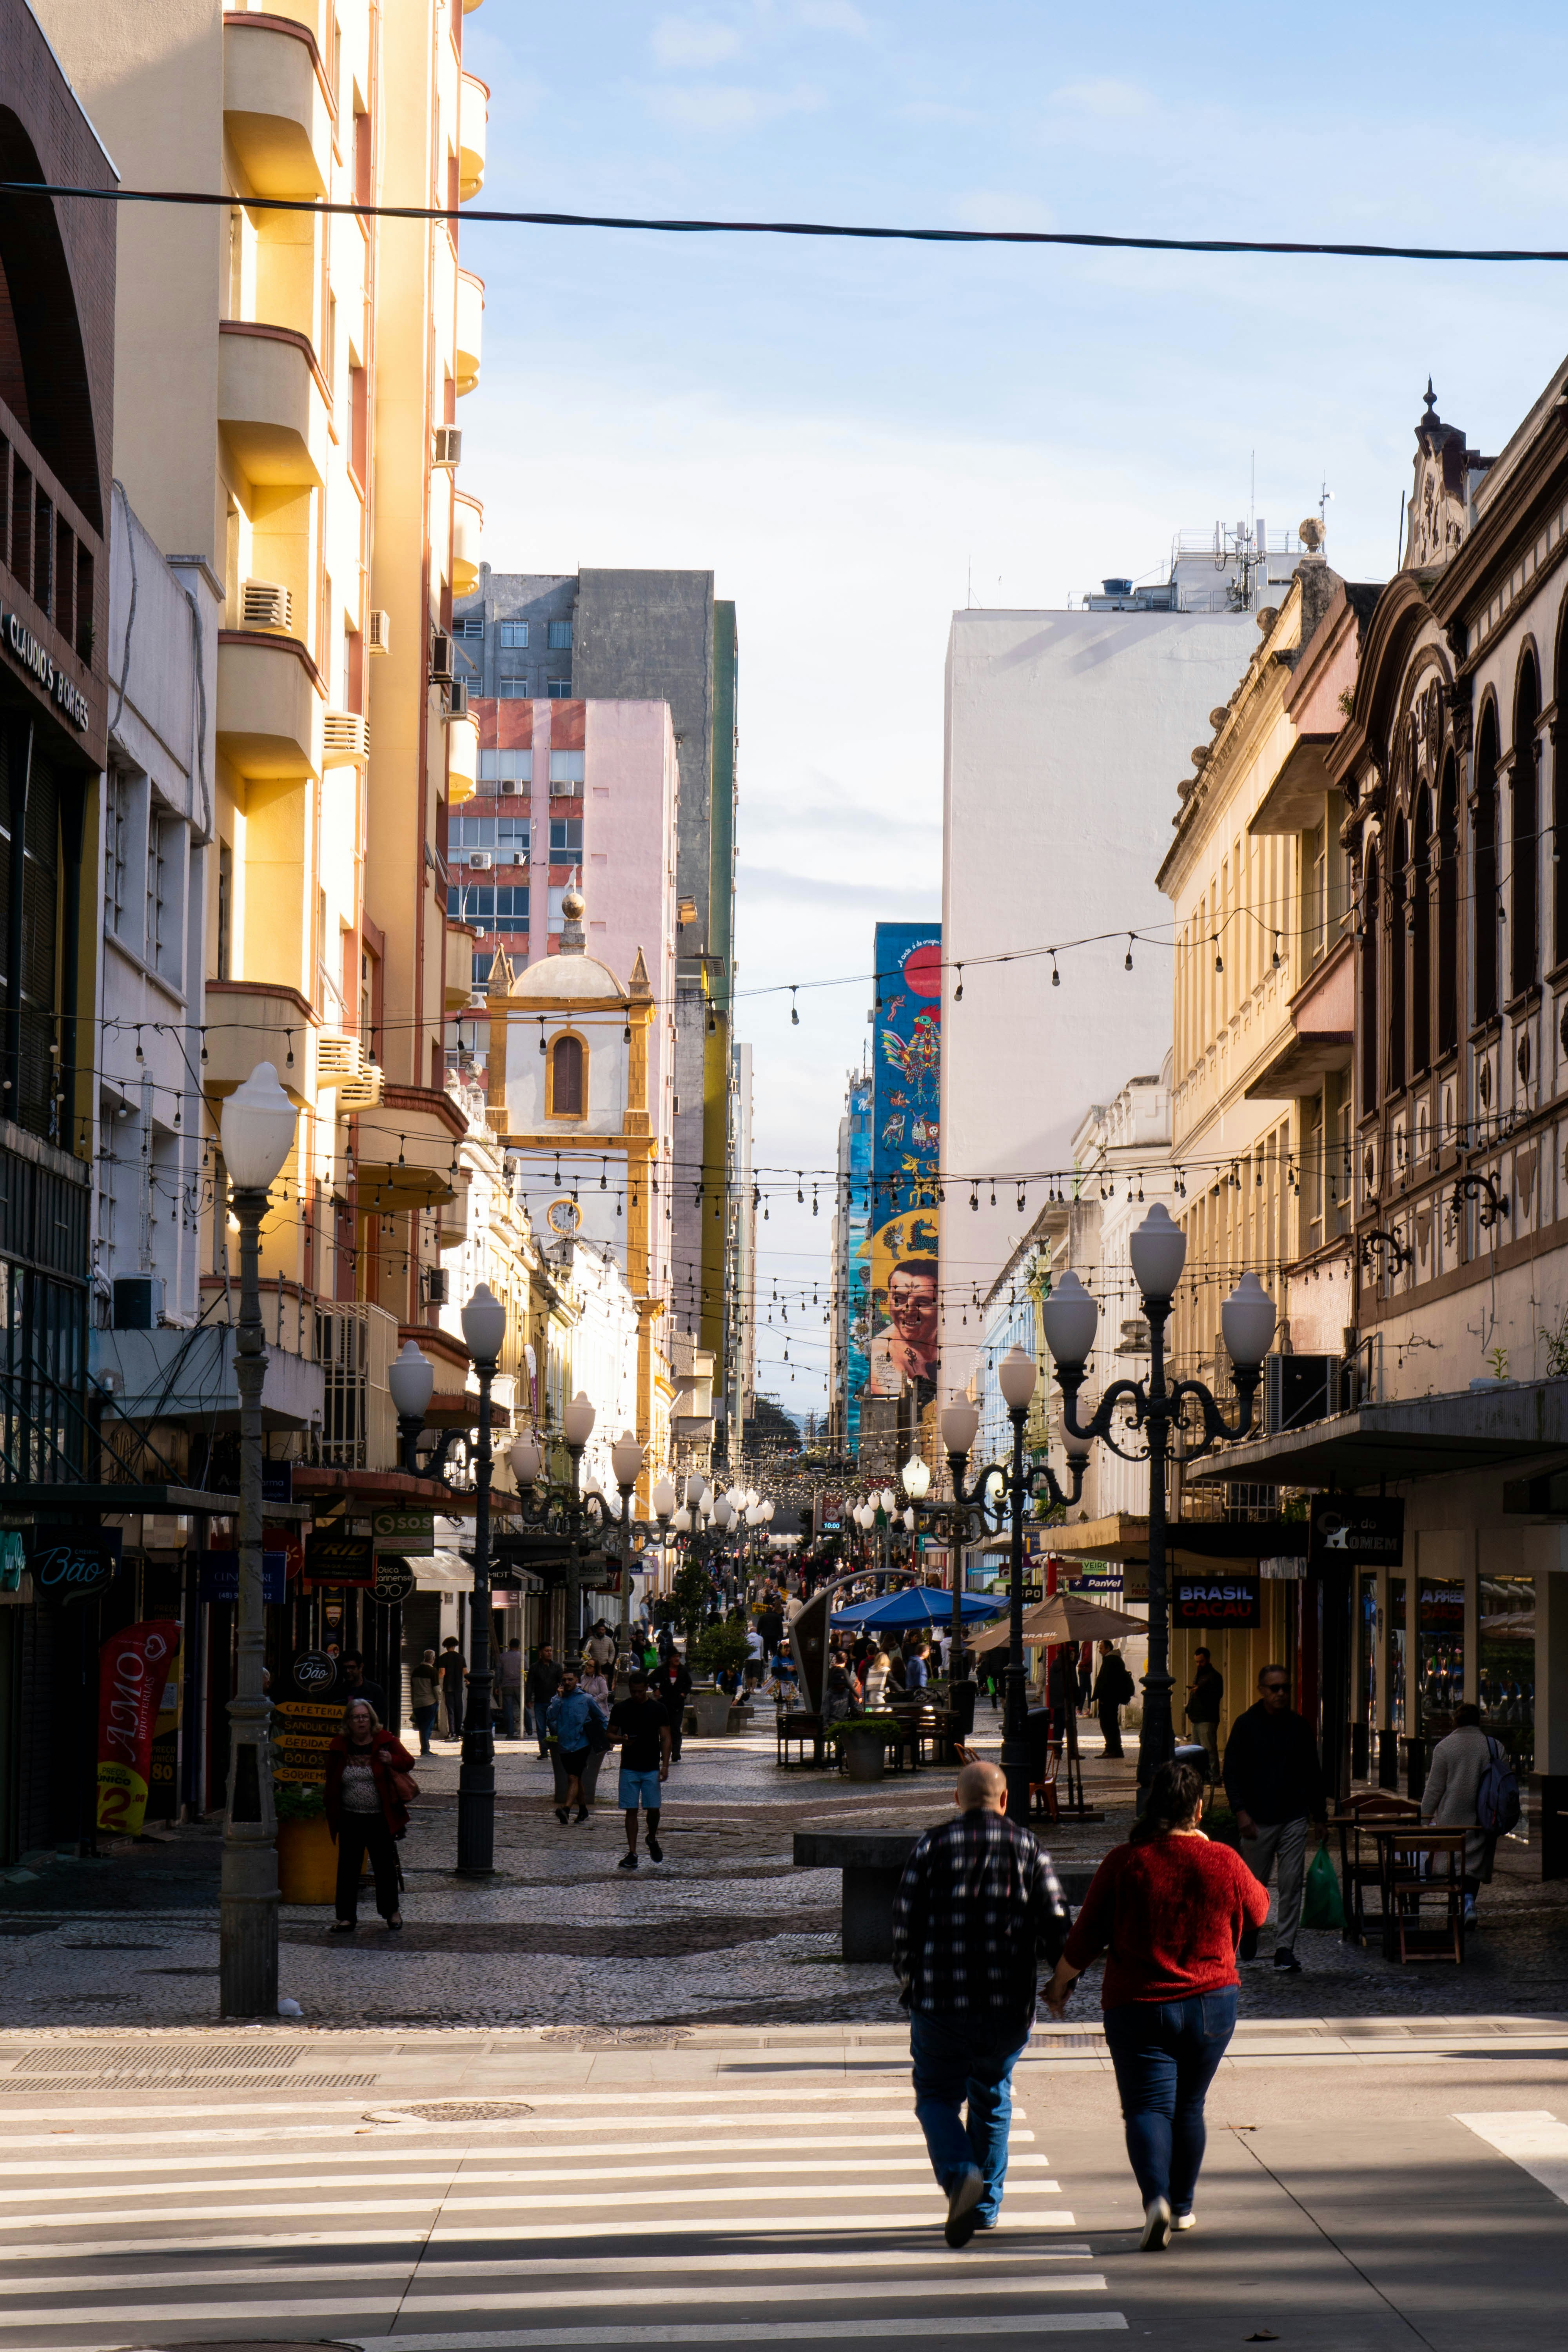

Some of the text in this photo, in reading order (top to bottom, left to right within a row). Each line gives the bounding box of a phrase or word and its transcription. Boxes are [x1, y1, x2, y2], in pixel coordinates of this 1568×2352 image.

[58, 671, 88, 732] BORGES
[901, 948, 911, 960] arte
[1361, 1518, 1377, 1529] do
[310, 1543, 368, 1556] TRID
[32, 1546, 105, 1585] Bão
[1180, 1585, 1253, 1601] BRASIL
[1181, 1601, 1251, 1617] CACAU
[294, 1662, 328, 1680] Bão
[106, 1651, 144, 1762] AMO
[286, 1704, 343, 1716] CAFETERIA
[284, 1719, 342, 1733] SANDUICHES
[285, 1737, 330, 1748] BEBIDAS
[284, 1752, 325, 1764] BOLOS
[151, 1763, 173, 1780] 80
